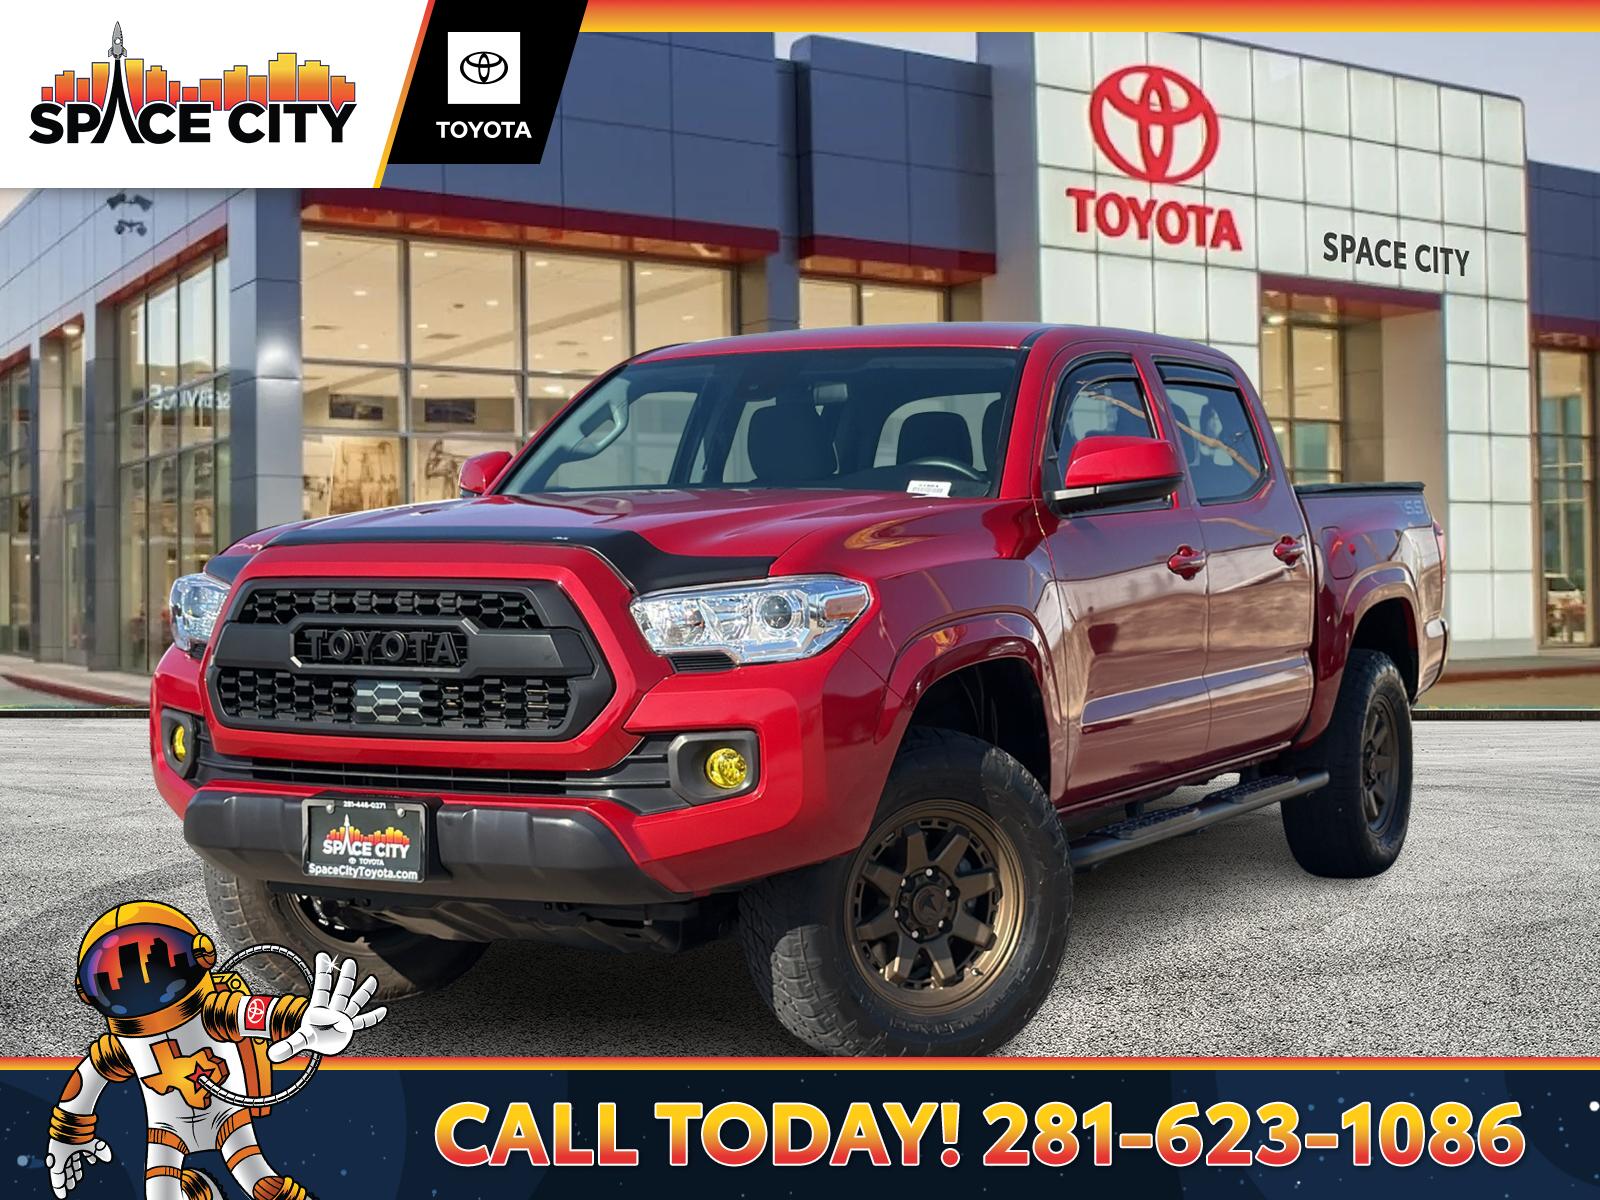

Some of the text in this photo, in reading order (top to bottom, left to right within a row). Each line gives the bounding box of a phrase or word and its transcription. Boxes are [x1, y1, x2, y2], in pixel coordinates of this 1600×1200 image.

[1066, 187, 1242, 251] TOYOTA
[1323, 231, 1470, 277] SPACE CITY
[304, 629, 461, 665] TOYOTA
[322, 839, 411, 859] SPACE CITY
[359, 857, 385, 866] TOYOTA
[308, 863, 418, 881] SpaceCityToyota.com
